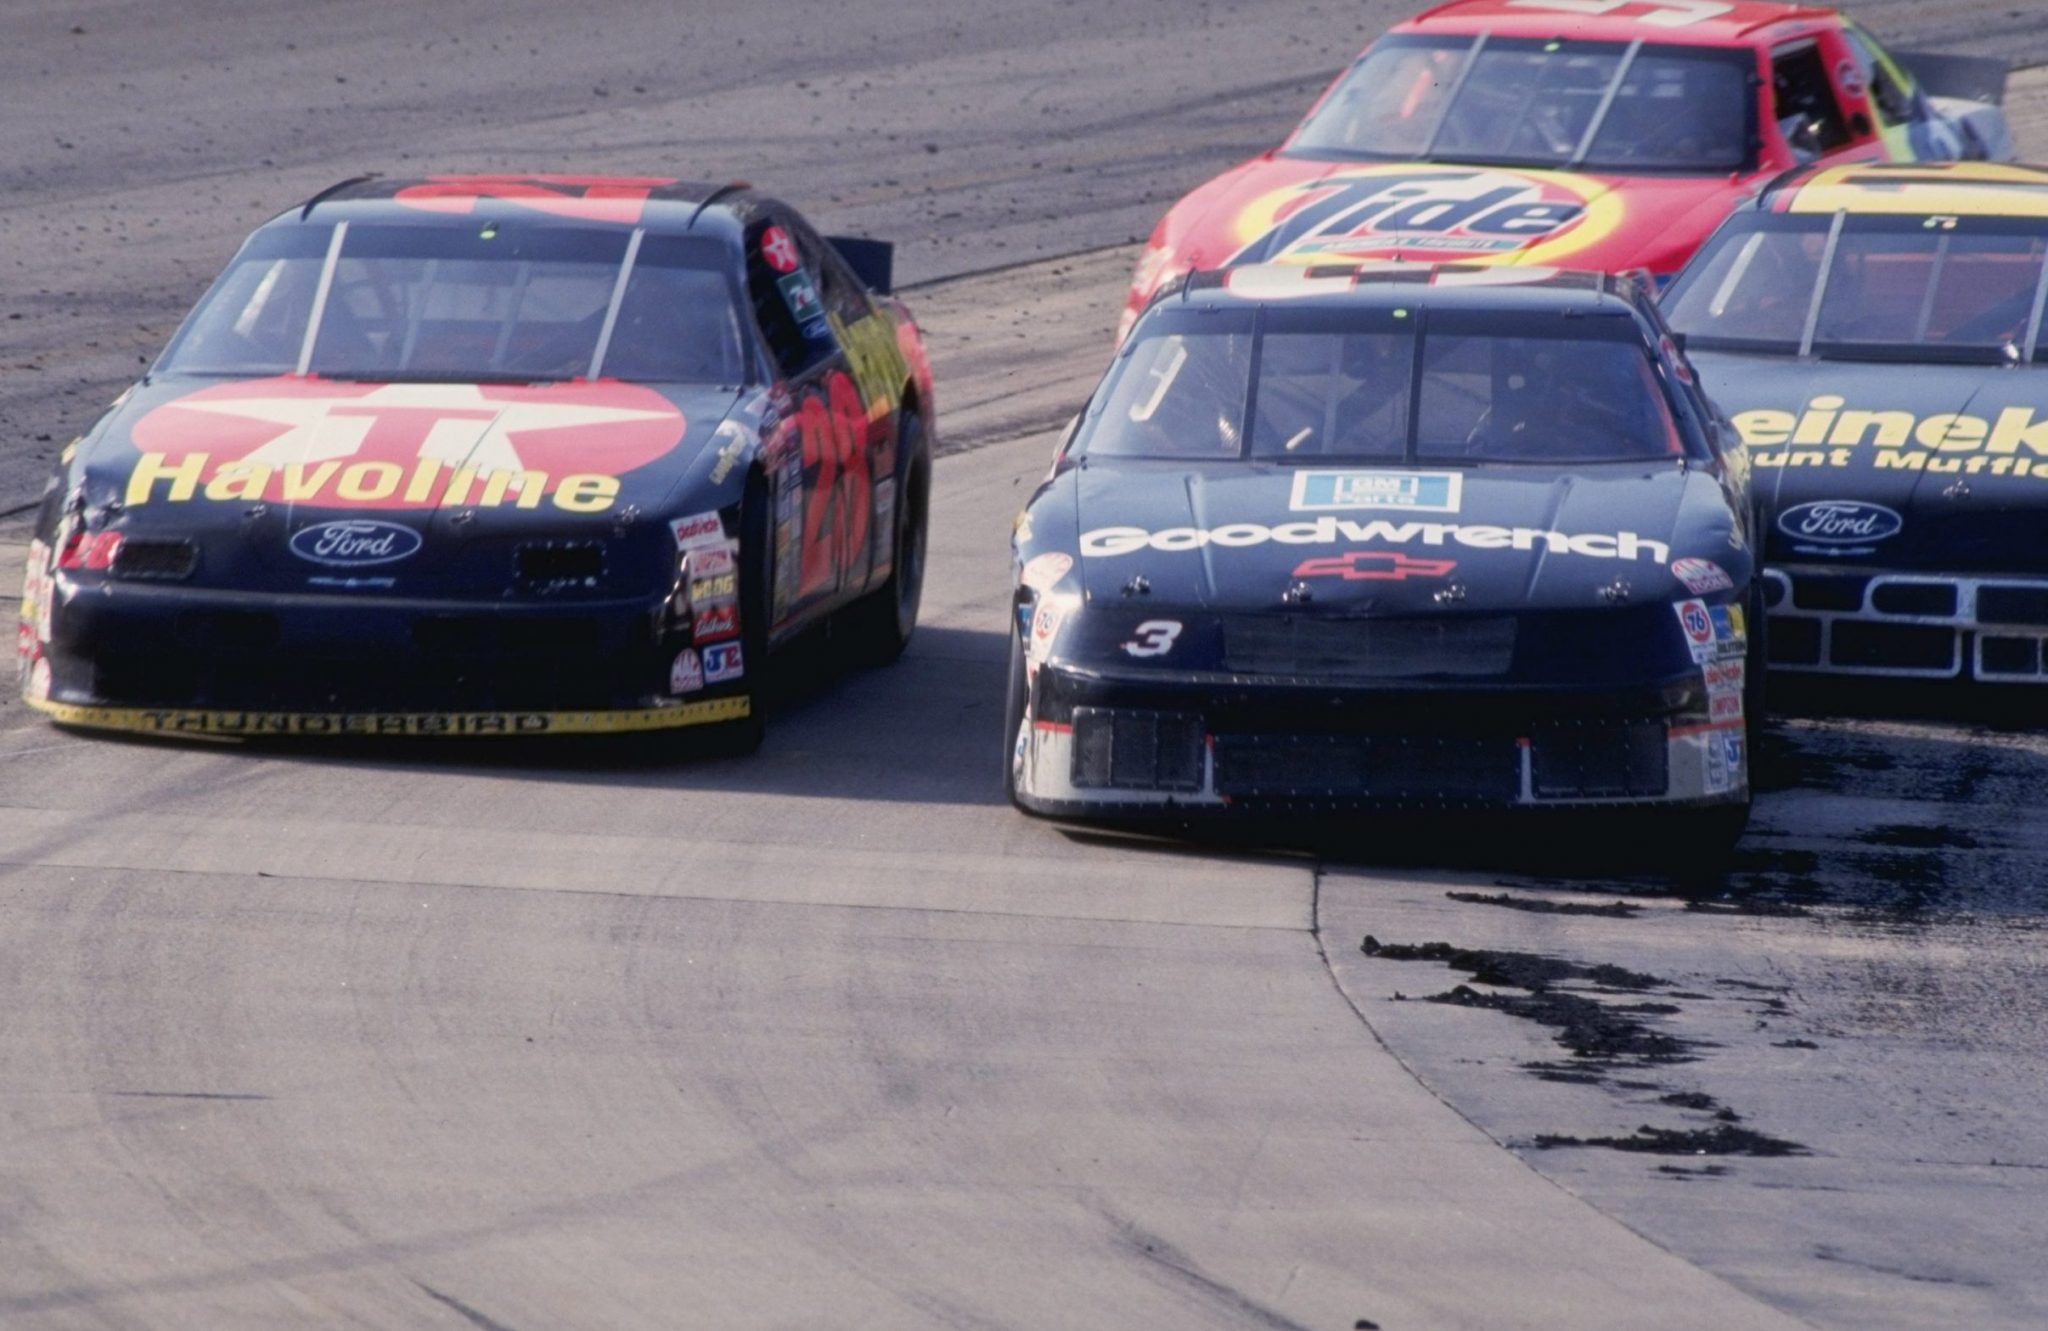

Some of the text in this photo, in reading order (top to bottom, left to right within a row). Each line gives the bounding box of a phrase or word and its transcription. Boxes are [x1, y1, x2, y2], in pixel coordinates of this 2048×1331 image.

[1233, 171, 1586, 266] Tide
[1750, 448, 1852, 468] unt
[126, 452, 621, 513] Havoline
[1801, 506, 1877, 534] Ford
[315, 526, 396, 555] Ford
[1079, 516, 1670, 563] Goodwrench
[1687, 610, 1707, 633] 76
[1120, 619, 1183, 658] 3
[706, 645, 742, 674] JE
